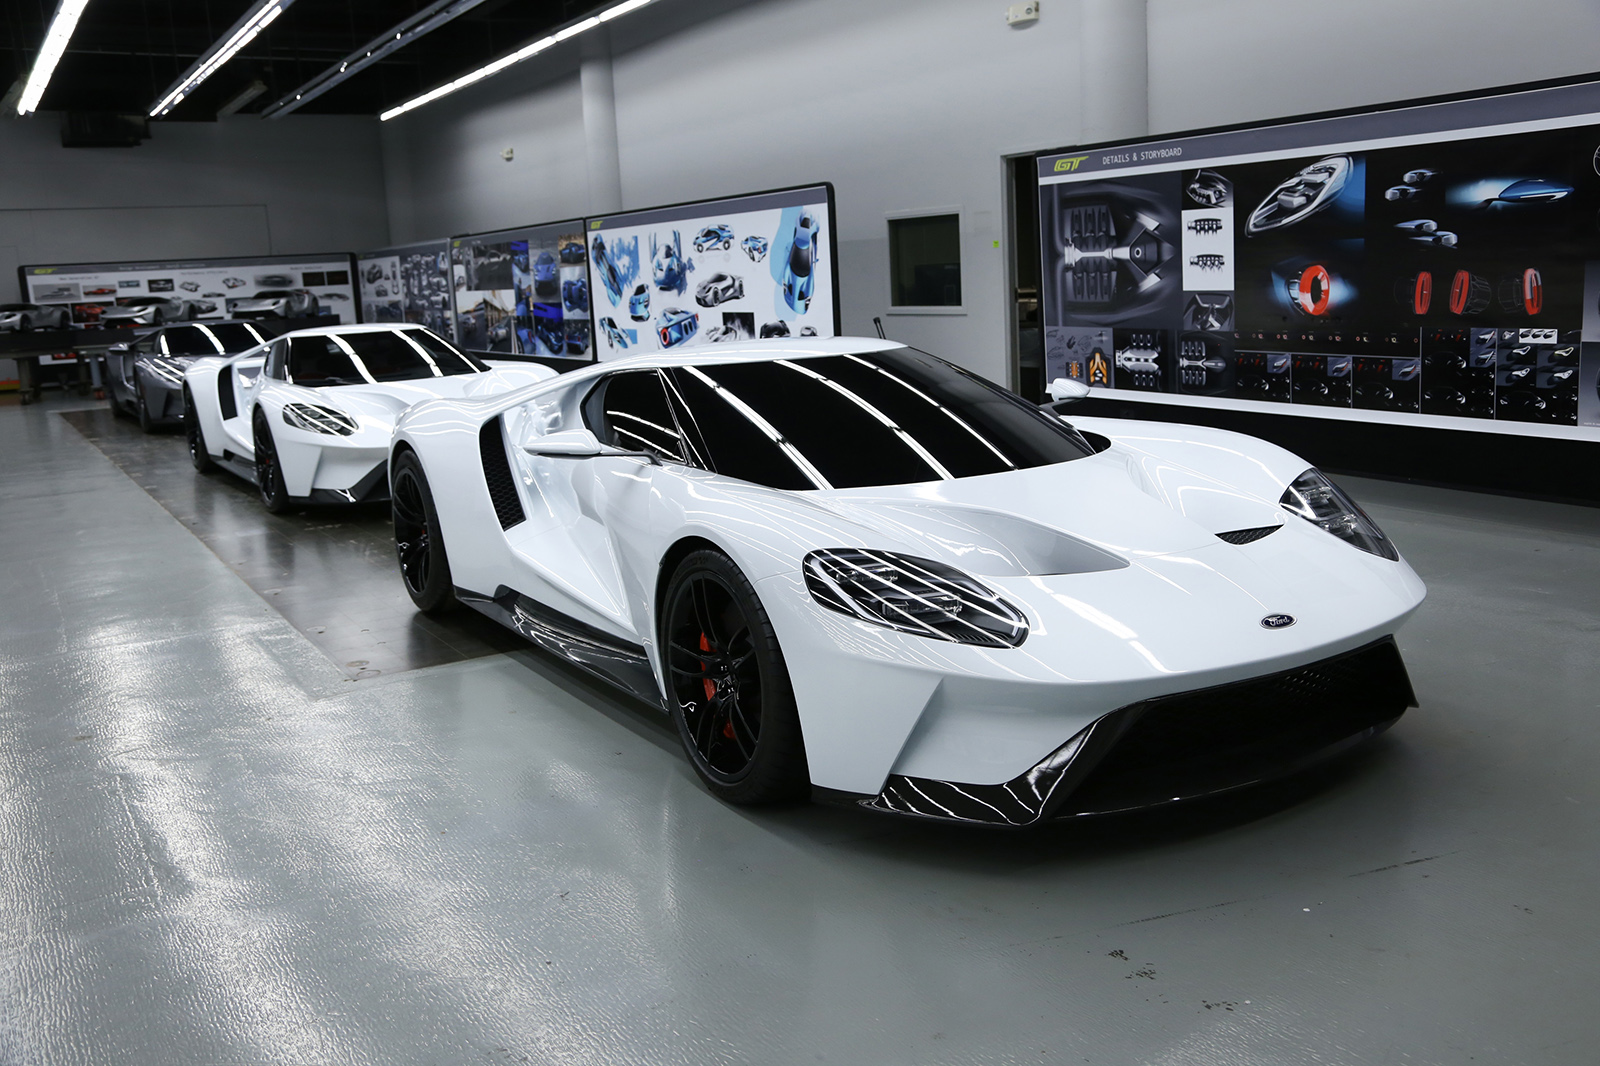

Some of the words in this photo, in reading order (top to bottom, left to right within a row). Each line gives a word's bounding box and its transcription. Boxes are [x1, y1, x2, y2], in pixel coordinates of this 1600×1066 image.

[1054, 155, 1089, 172] GT
[1102, 154, 1130, 165] DETAILS
[1132, 153, 1138, 161] &
[1140, 147, 1183, 160] STORYBOARD
[1262, 615, 1291, 627] Ford
